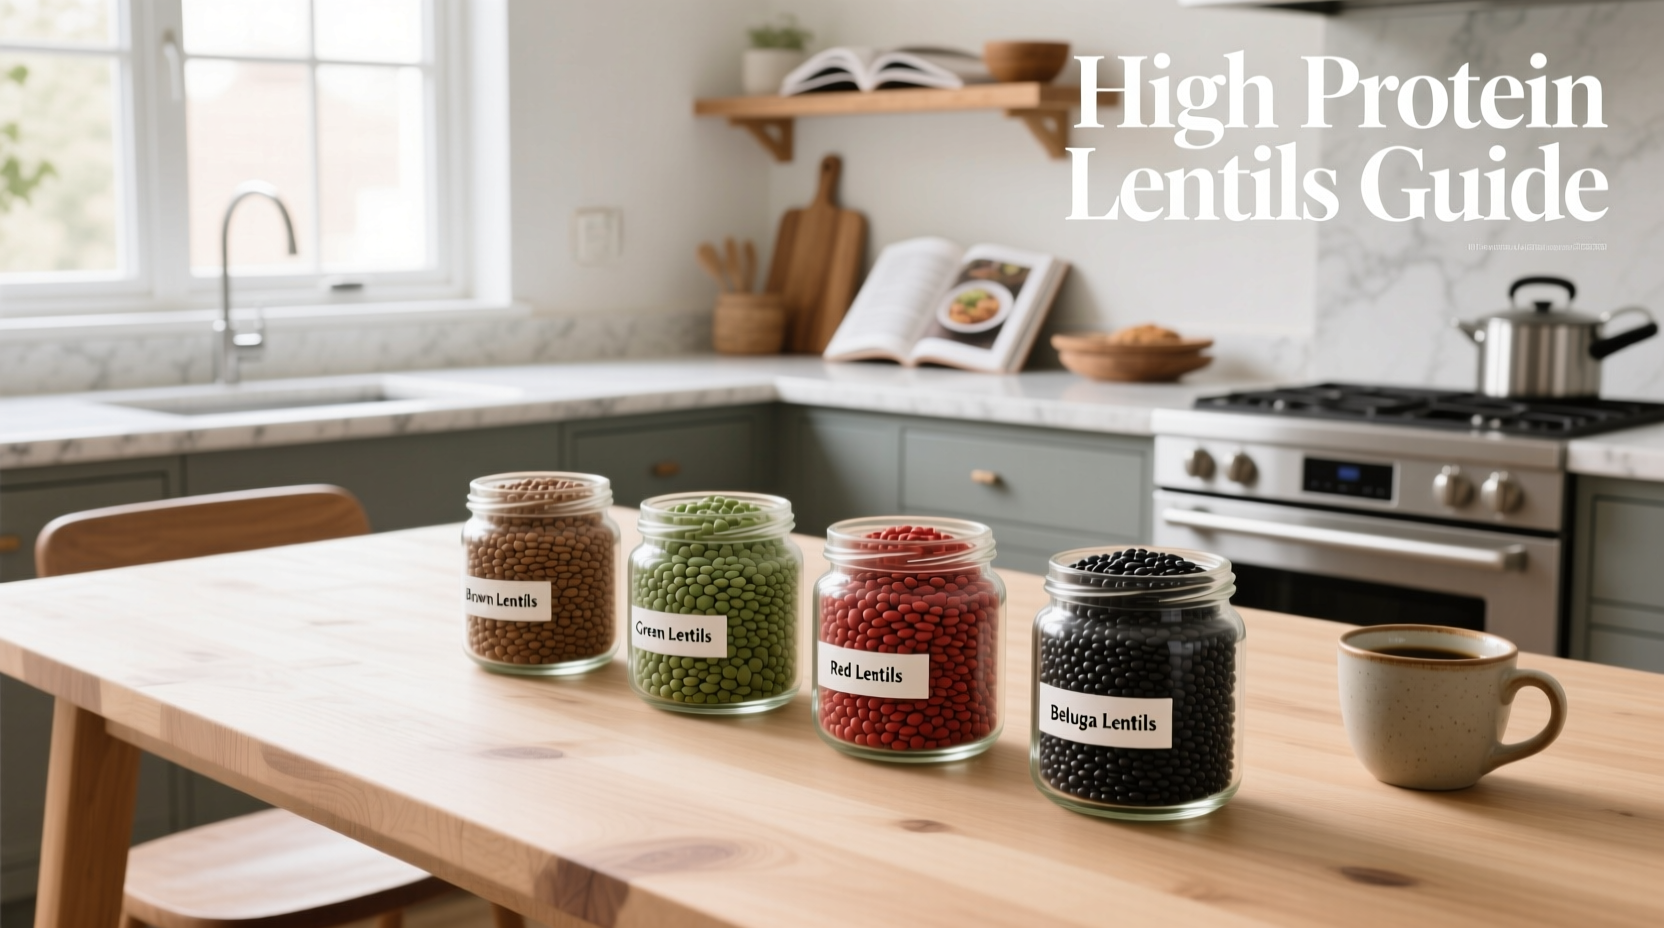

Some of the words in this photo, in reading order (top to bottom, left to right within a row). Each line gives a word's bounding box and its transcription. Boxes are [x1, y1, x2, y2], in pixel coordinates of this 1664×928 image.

[830, 660, 852, 678] Red
[856, 664, 903, 683] Lentils
[1051, 704, 1097, 731] Beluga
[1102, 712, 1157, 731] Lentils
